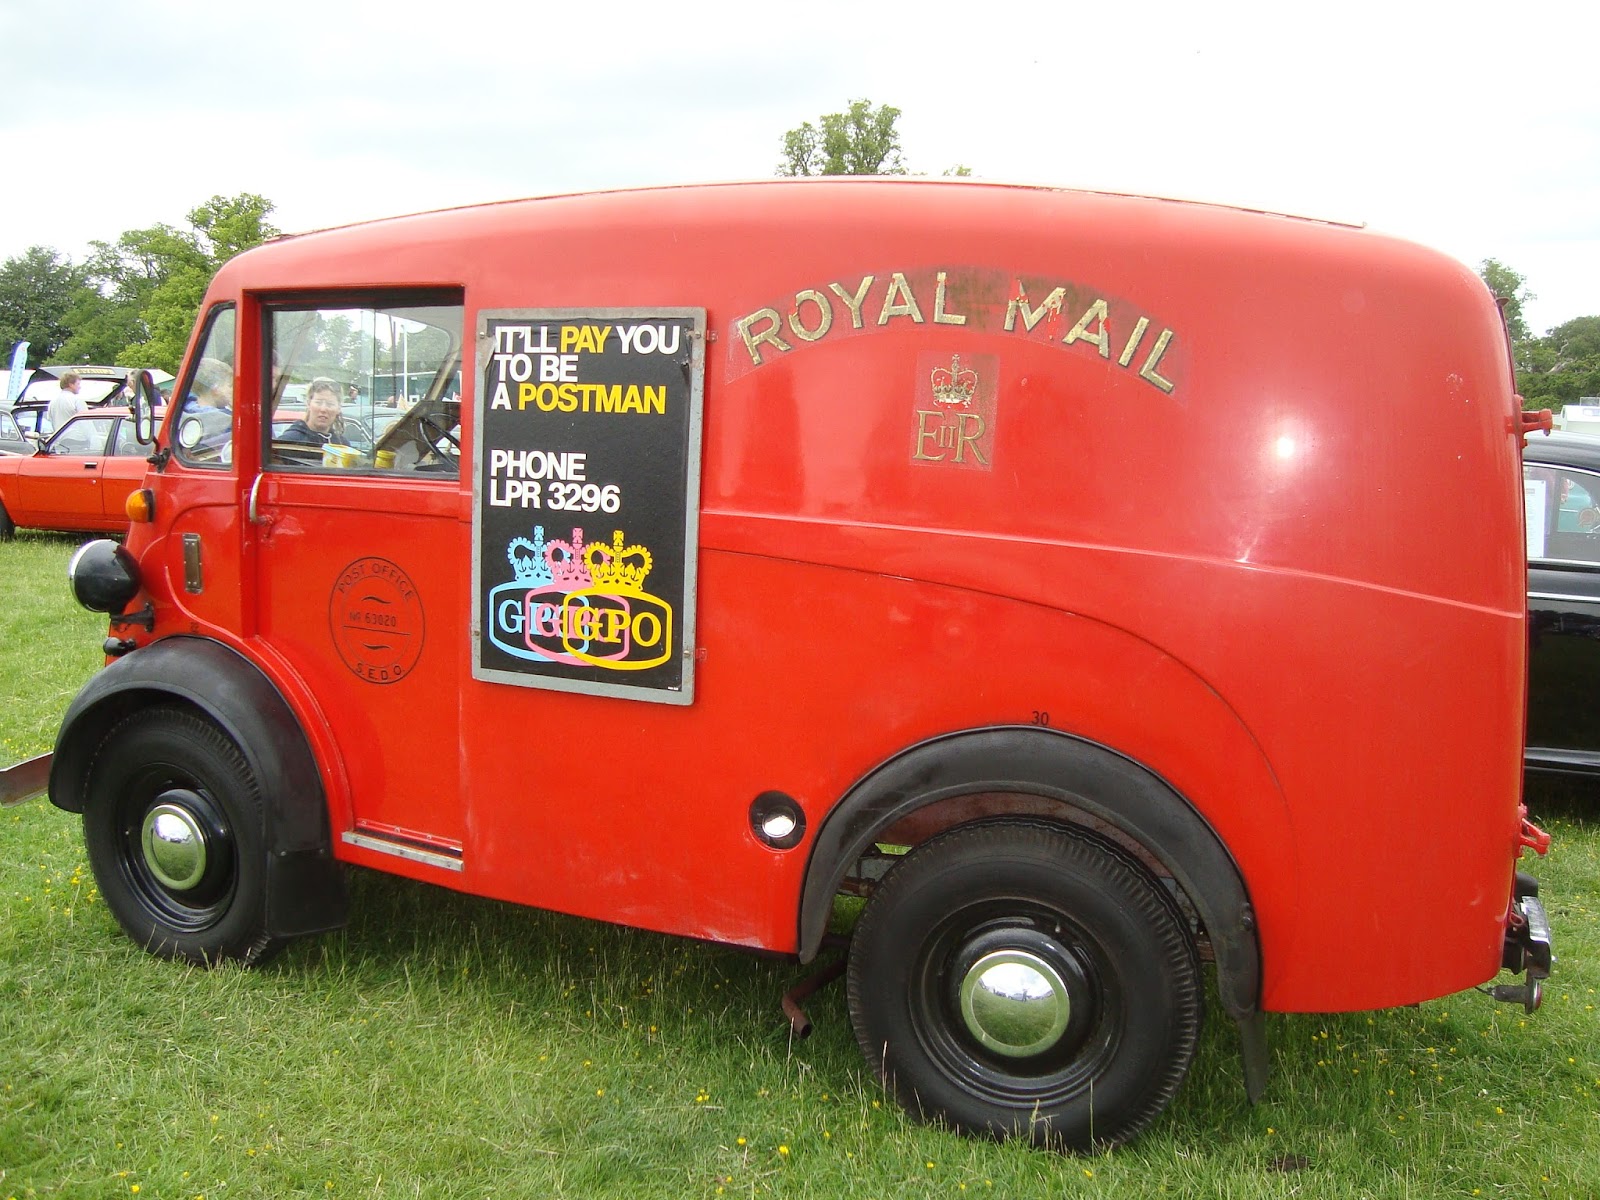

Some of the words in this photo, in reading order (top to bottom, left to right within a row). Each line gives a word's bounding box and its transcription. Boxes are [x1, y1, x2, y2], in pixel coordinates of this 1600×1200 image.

[494, 325, 557, 354] IT'LL
[560, 325, 612, 353] PAY
[616, 325, 680, 355] YOU
[738, 272, 966, 365] ROYAL
[1003, 279, 1175, 394] MAIL
[494, 353, 533, 382] TO
[539, 354, 579, 383] BE
[490, 382, 512, 410] A
[518, 383, 666, 414] POSTMAN
[490, 450, 586, 481] PHONE
[490, 479, 541, 509] LPR
[547, 482, 621, 514] 3296
[338, 565, 364, 594] POST
[371, 563, 414, 601] OFFICE
[365, 612, 397, 628] 63020
[573, 606, 662, 647] GPO
[1031, 710, 1049, 726] 30
